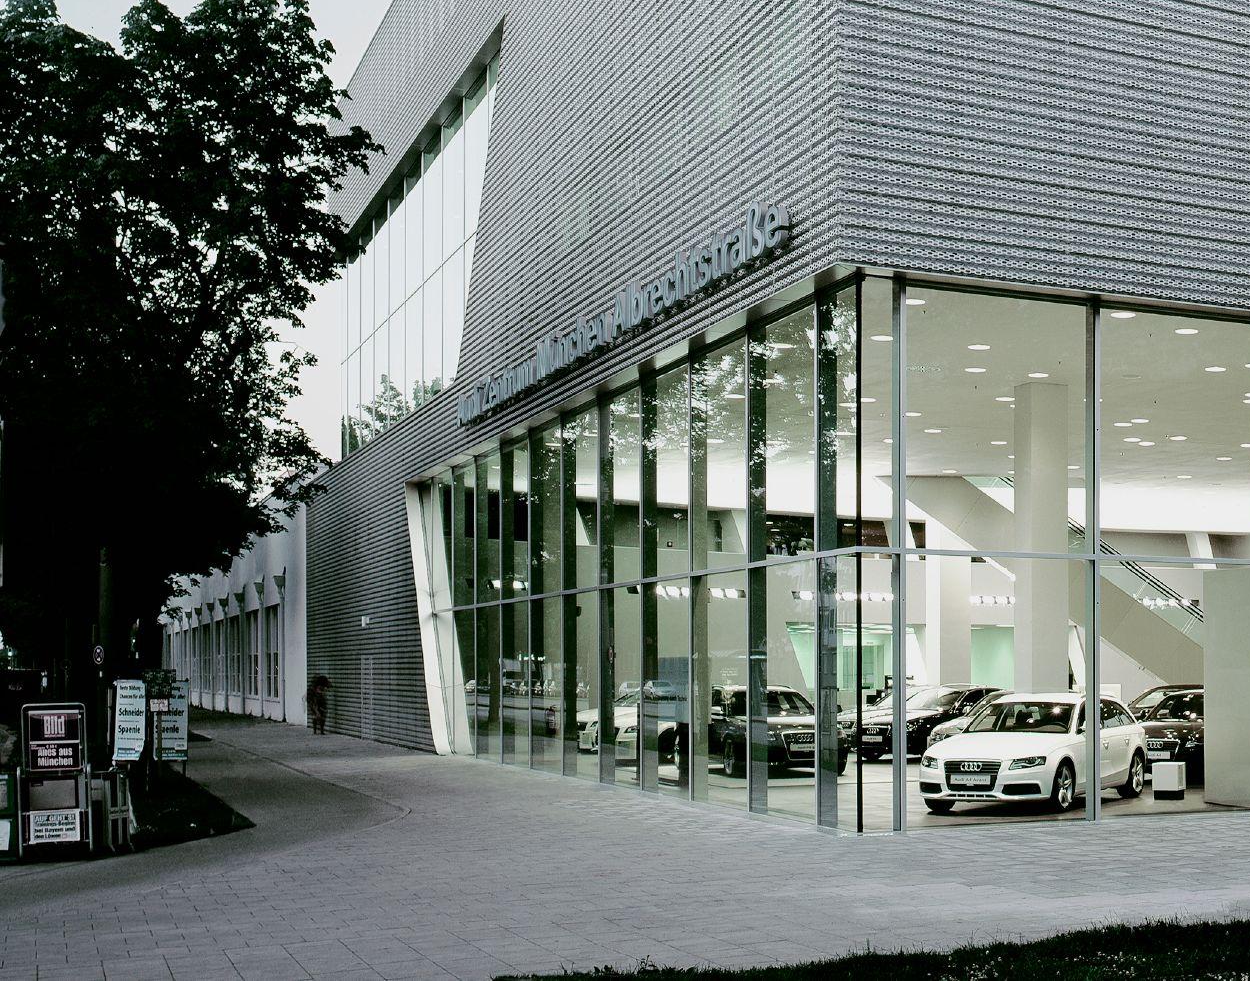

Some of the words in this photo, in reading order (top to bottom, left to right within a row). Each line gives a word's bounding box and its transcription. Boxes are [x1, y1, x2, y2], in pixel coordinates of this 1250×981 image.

[481, 358, 537, 412] Zentrum
[535, 311, 612, 381] München
[611, 201, 790, 339] Albrechtstraße
[118, 707, 144, 716] Schneider
[43, 715, 65, 734] Bild
[118, 724, 140, 735] Spaenle
[58, 747, 73, 756] aus
[37, 756, 73, 766] München
